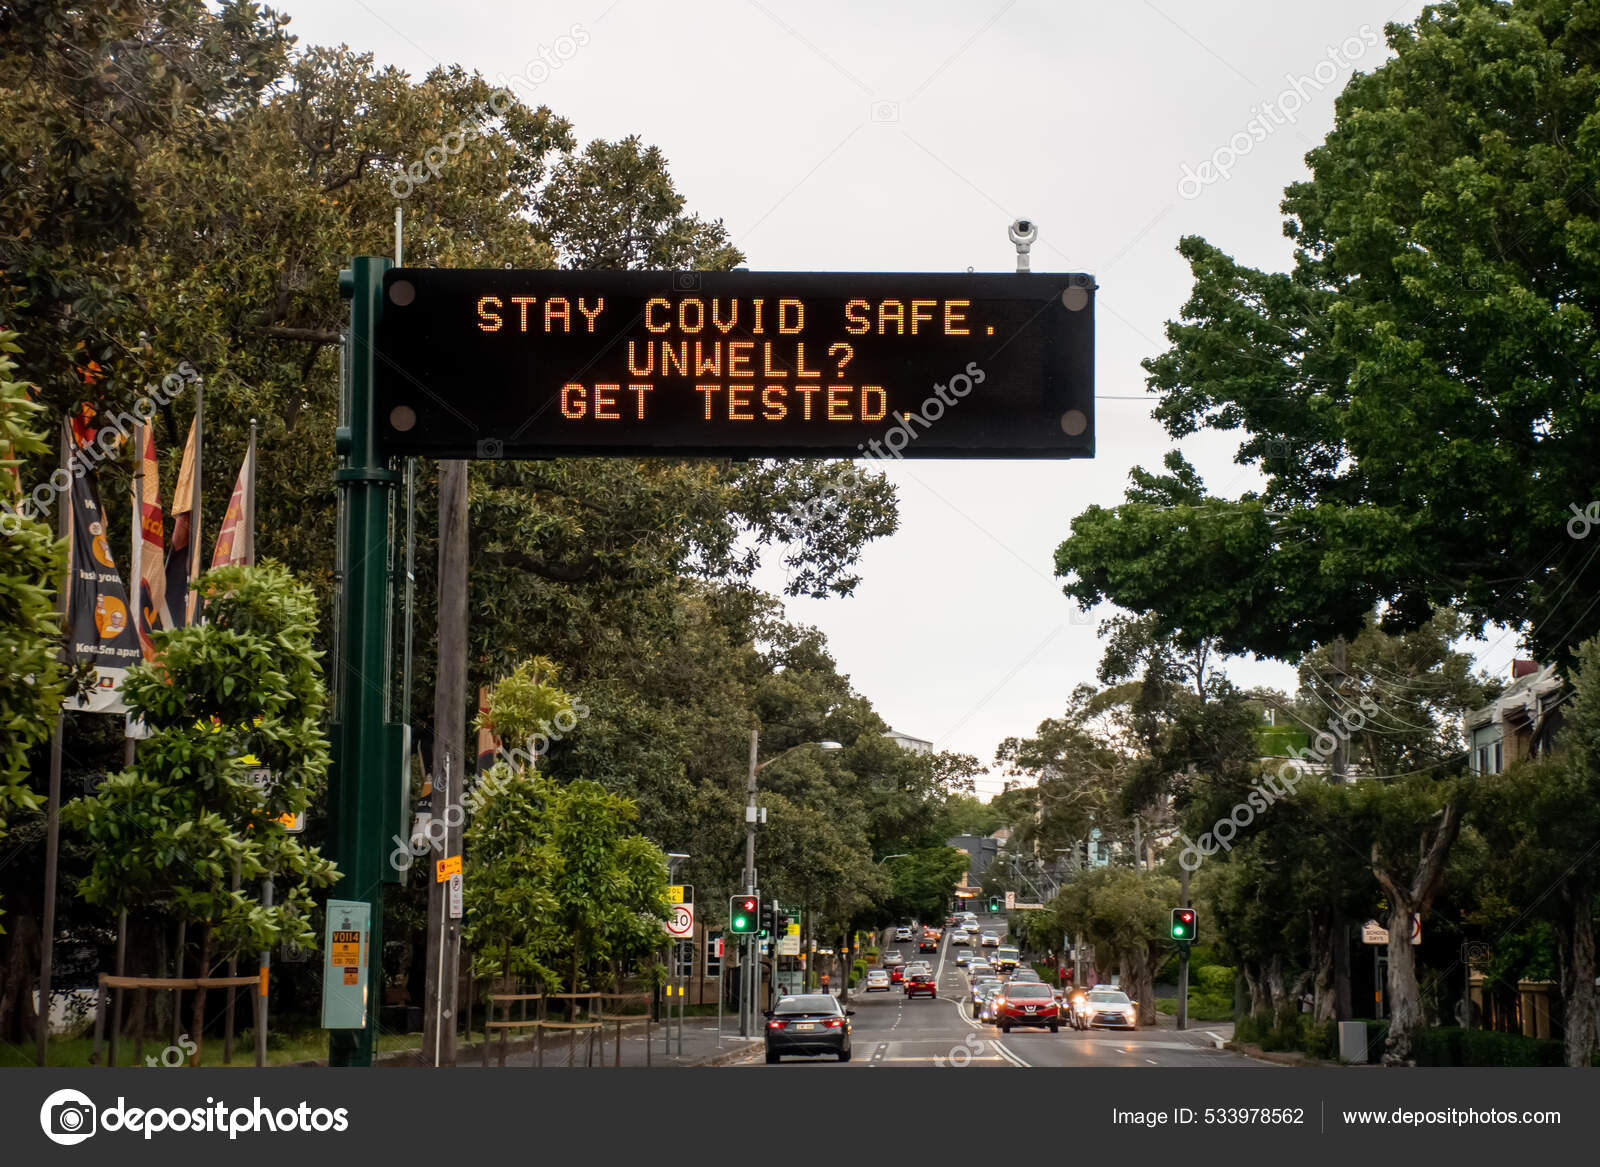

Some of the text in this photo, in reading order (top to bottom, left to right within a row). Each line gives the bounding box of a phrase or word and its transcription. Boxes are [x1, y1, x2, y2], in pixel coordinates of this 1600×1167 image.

[477, 296, 994, 335] STAY COVID SAFE.
[628, 341, 854, 378] UNWELL?
[561, 384, 911, 421] GET TESTED.
[116, 648, 140, 658] apart
